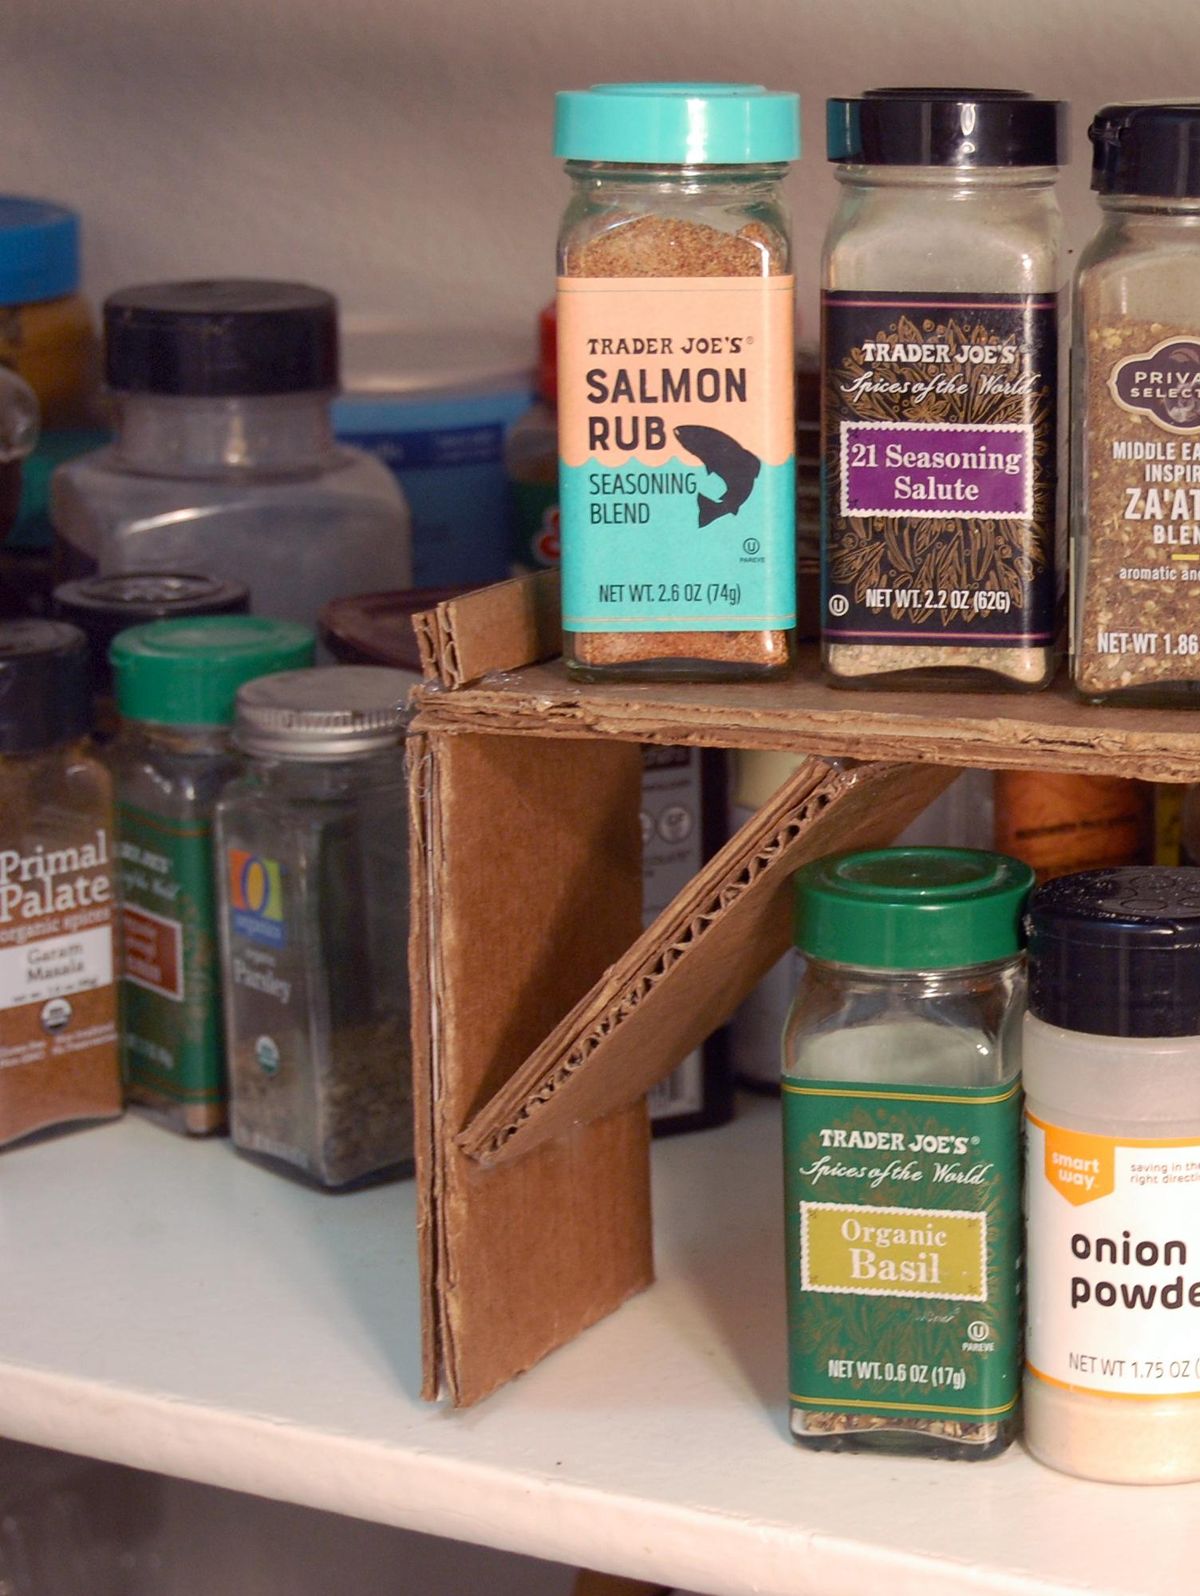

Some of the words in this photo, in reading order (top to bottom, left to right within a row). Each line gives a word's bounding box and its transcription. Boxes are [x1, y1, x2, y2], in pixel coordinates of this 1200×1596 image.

[587, 337, 674, 355] TRADER
[680, 337, 743, 354] JOE'S
[862, 343, 951, 363] TRADER
[954, 345, 1017, 364] JOE'S
[585, 367, 747, 404] SALMON
[840, 371, 911, 403] Spices
[978, 373, 1041, 395] World
[588, 416, 667, 451] RUB
[851, 444, 878, 468] 21
[885, 444, 1021, 474] Seasoning
[1113, 442, 1175, 461] MIDDLE
[589, 473, 697, 496] SEASONING
[894, 477, 979, 500] Salute
[590, 503, 650, 524] BLEND
[1119, 566, 1177, 582] aromatic
[599, 584, 625, 603] NET
[629, 584, 655, 602] WT.
[658, 584, 680, 603] 2.6
[684, 584, 702, 603] OZ
[707, 583, 741, 605] (74g)
[865, 588, 892, 607] NET
[895, 589, 922, 608] WT.
[925, 589, 947, 609] 2.2
[951, 589, 969, 610] OZ
[973, 590, 1010, 611] (62G)
[1098, 632, 1128, 653] NET
[1132, 634, 1158, 654] WT
[1163, 634, 1198, 655] 1.86
[0, 829, 108, 883] Primal
[0, 874, 111, 922] Palate
[819, 1128, 906, 1151] TRADER
[908, 1134, 969, 1154] JOE'S
[799, 1156, 865, 1184] Spices
[931, 1161, 994, 1186] World
[1052, 1152, 1099, 1173] smart
[1130, 1162, 1168, 1174] saving
[1172, 1162, 1181, 1171] in
[1059, 1170, 1095, 1191] way
[1130, 1174, 1158, 1185] right
[841, 1218, 948, 1248] Organic
[1071, 1230, 1187, 1266] onion
[849, 1248, 941, 1284] Basil
[828, 1359, 854, 1378] NET
[856, 1362, 882, 1380] WT.
[884, 1362, 906, 1382] 0.6
[909, 1364, 928, 1383] OZ
[931, 1365, 966, 1389] (17g)
[1069, 1352, 1098, 1374] NET
[1101, 1358, 1126, 1378] WT
[1130, 1360, 1164, 1379] 1.75
[1169, 1359, 1190, 1378] OZ
